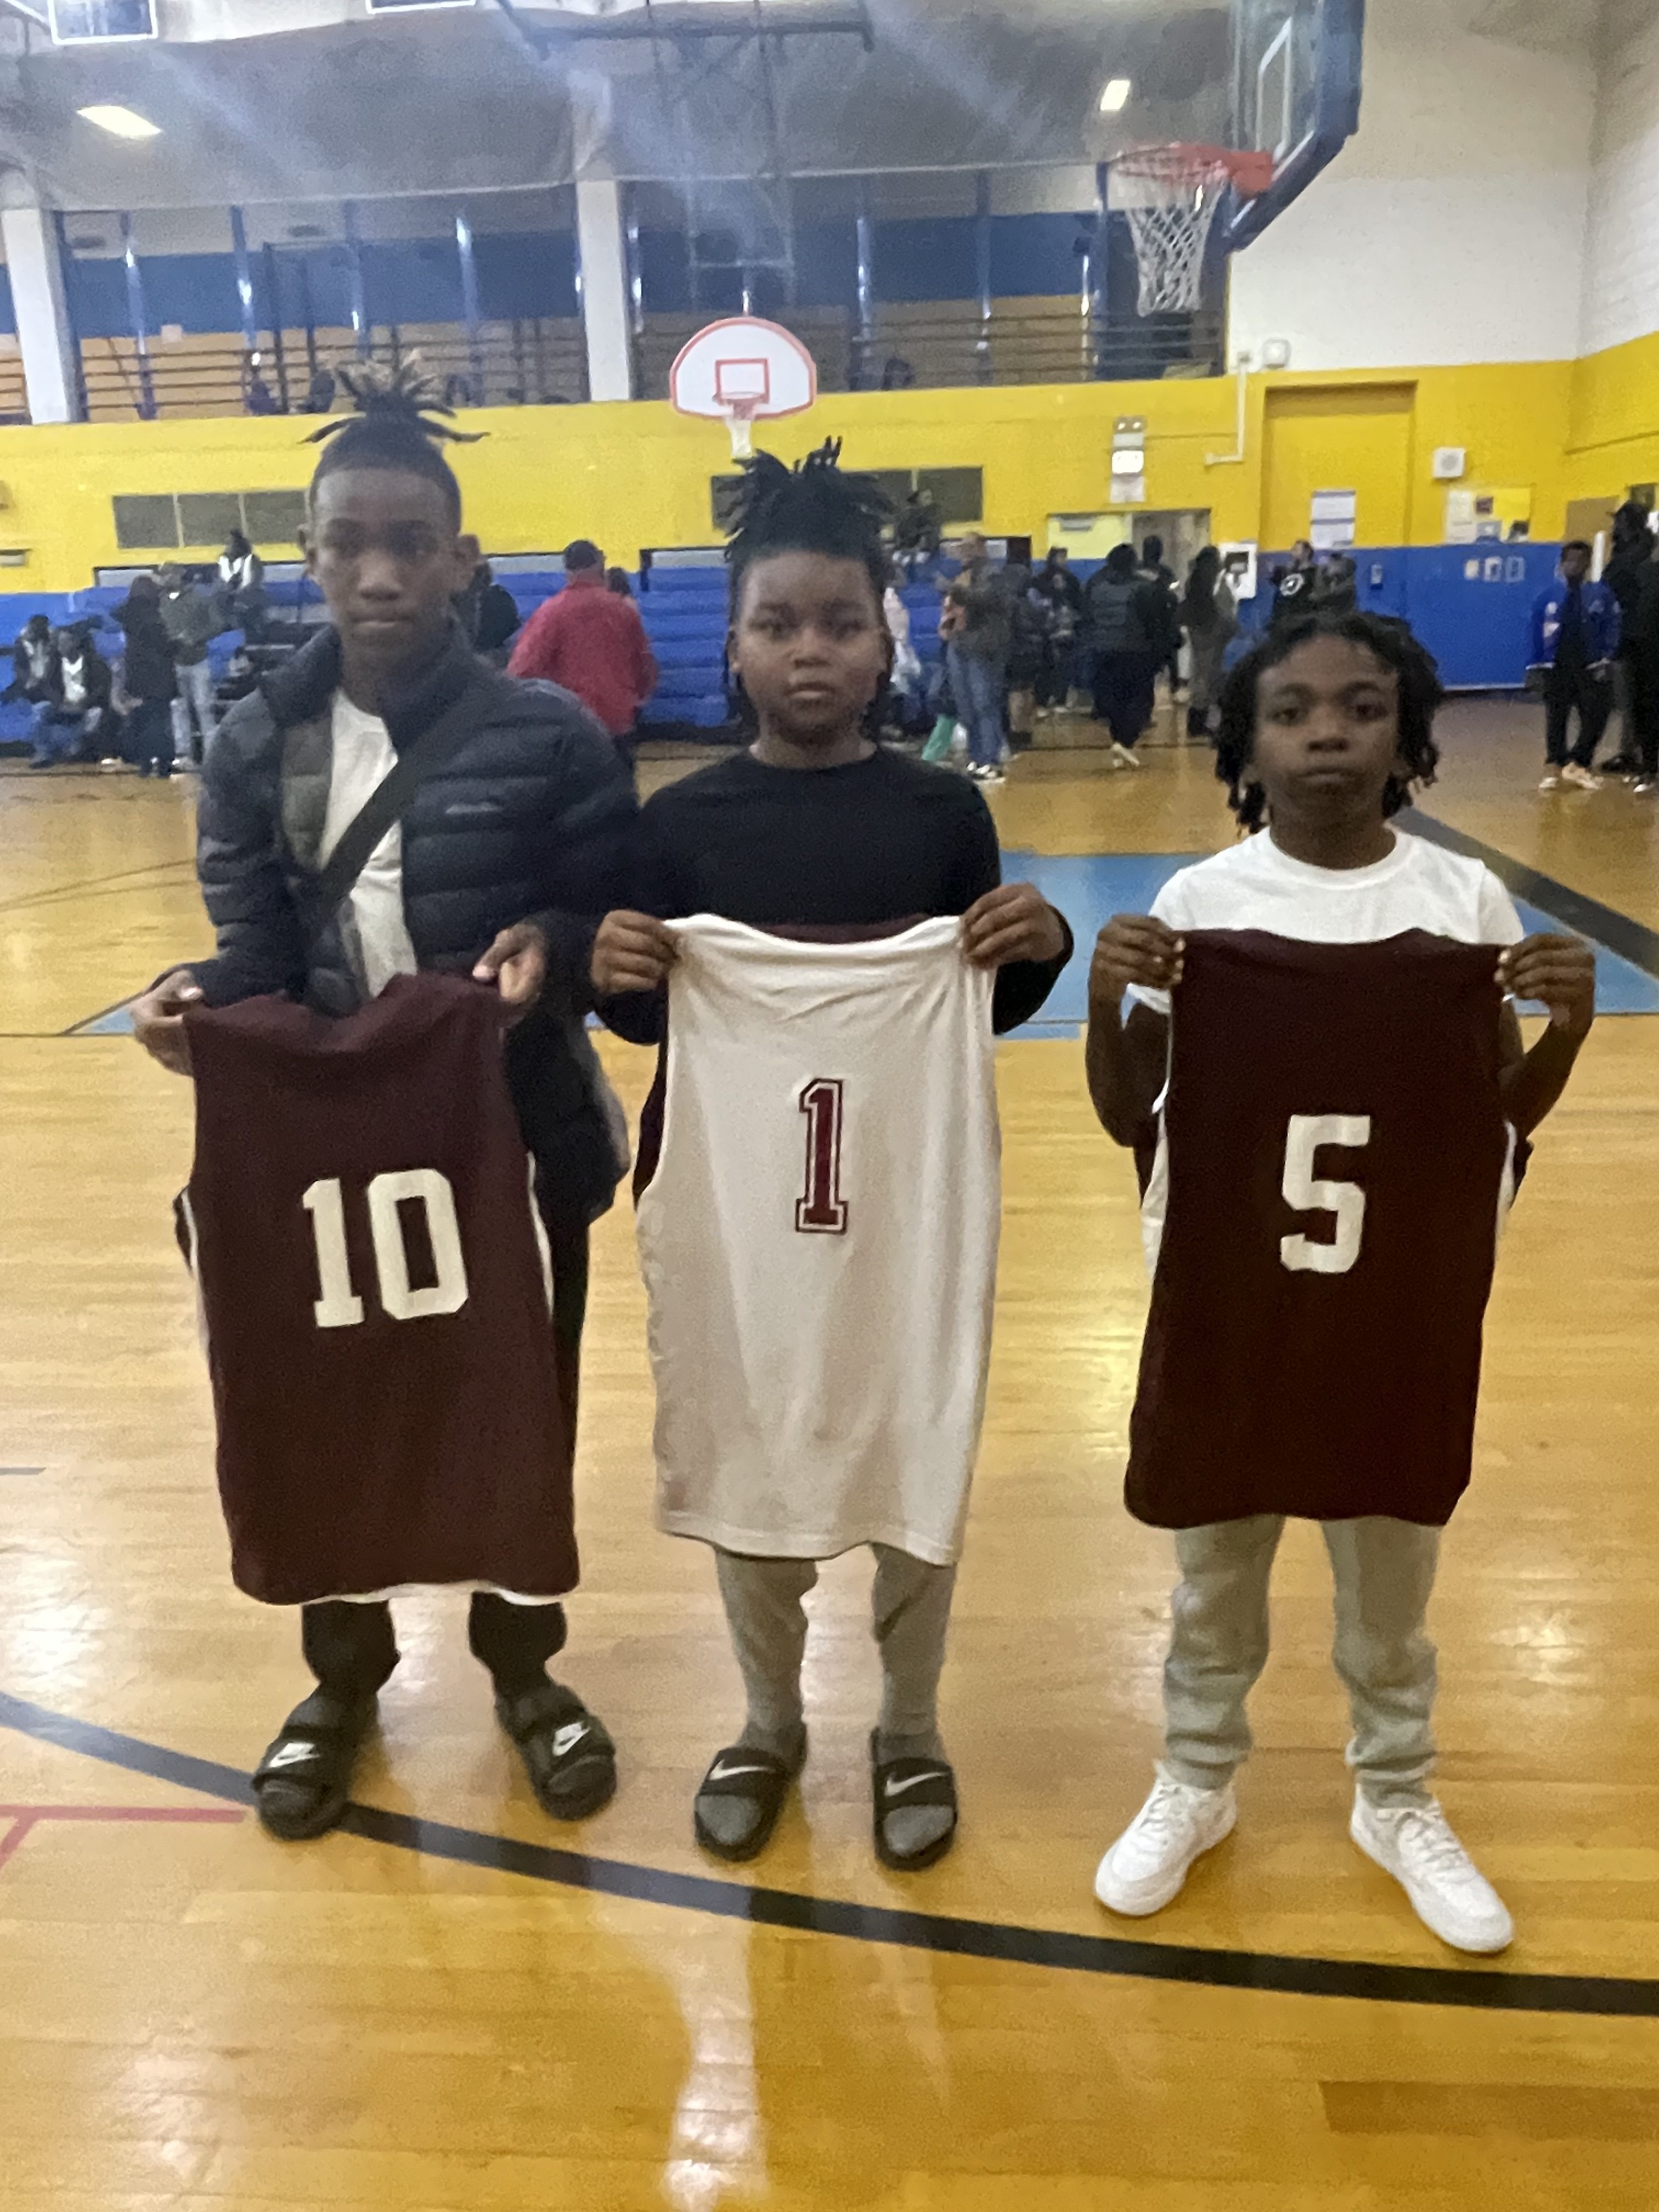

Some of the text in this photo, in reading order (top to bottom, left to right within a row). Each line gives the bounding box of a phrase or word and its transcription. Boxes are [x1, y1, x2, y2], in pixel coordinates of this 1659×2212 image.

[795, 1078, 848, 1234] 1
[1280, 1114, 1370, 1273] 5
[302, 1169, 469, 1328] 10
